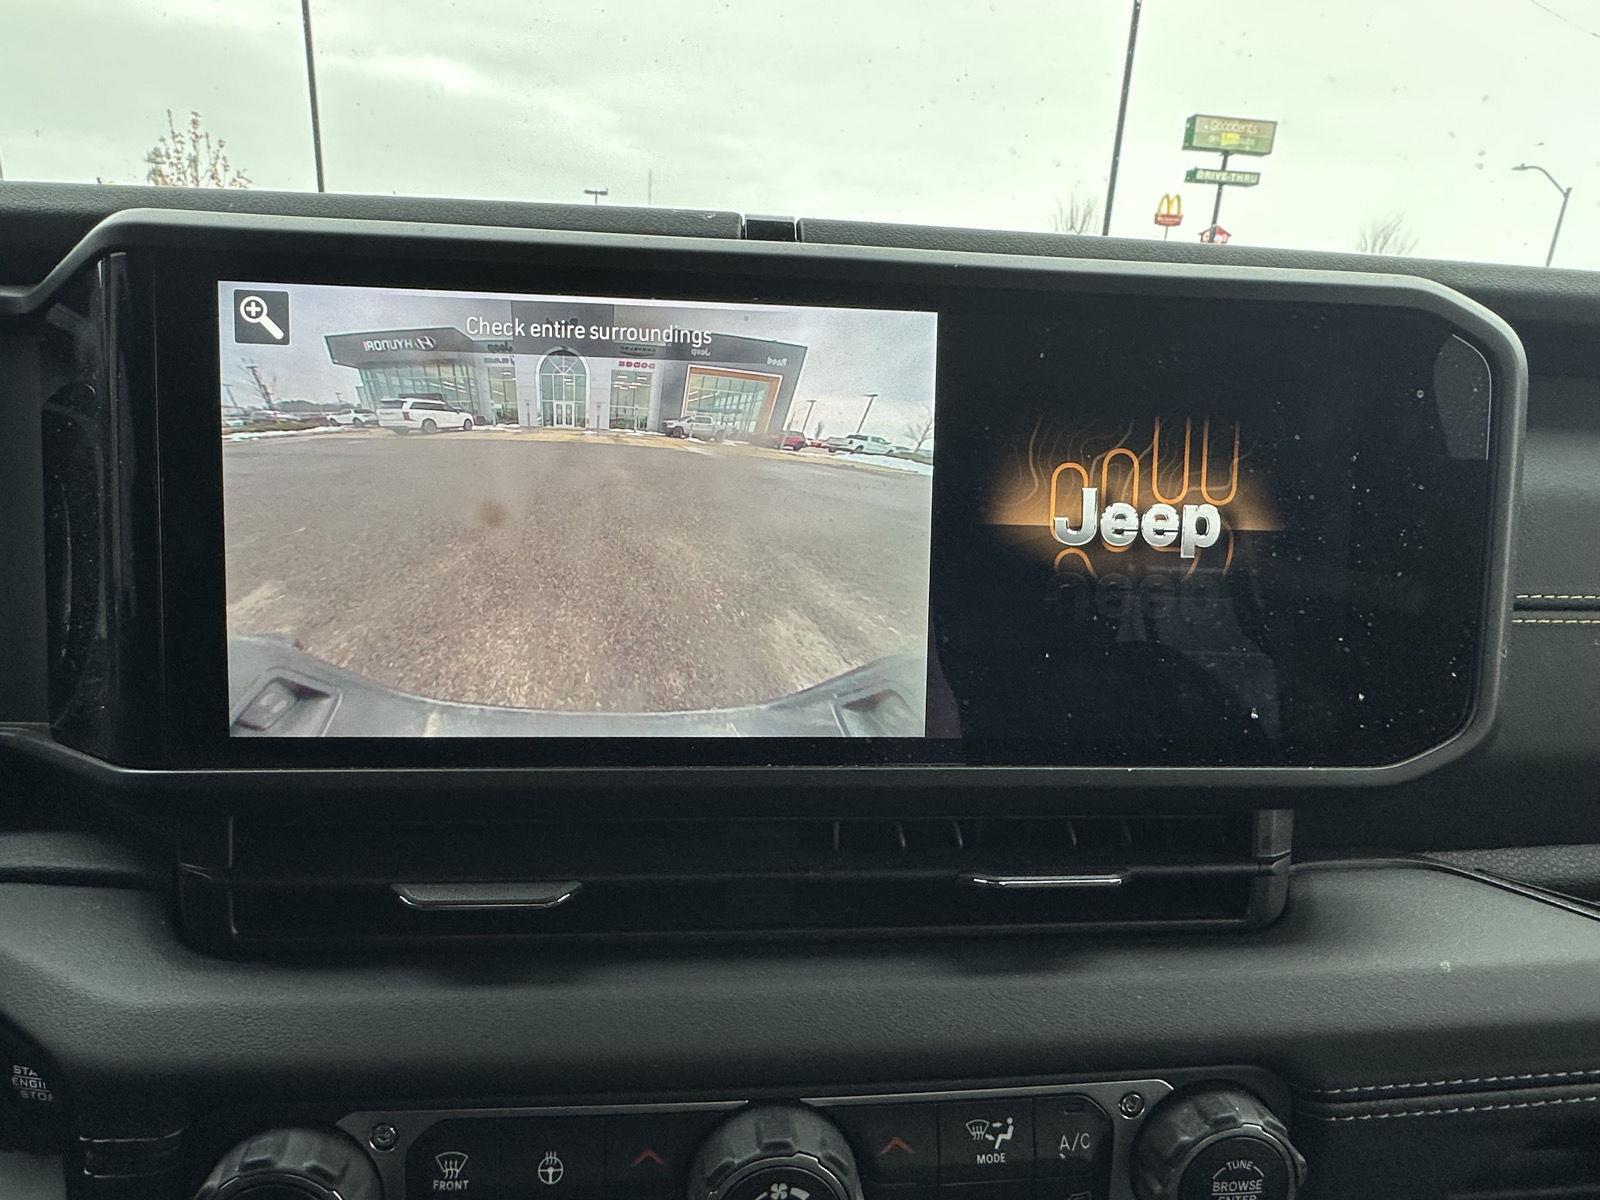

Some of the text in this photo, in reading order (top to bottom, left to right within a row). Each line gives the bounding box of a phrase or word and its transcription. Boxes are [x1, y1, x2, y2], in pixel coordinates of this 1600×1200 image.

[466, 316, 713, 348] Check entire surroundings
[1053, 487, 1222, 559] Jeep
[13, 1064, 38, 1076] STA
[1059, 1133, 1091, 1152] A/C
[976, 1152, 1006, 1165] MODE
[1225, 1159, 1254, 1171] TUNE
[433, 1180, 470, 1191] FRONT
[1212, 1179, 1263, 1192] BROWSE
